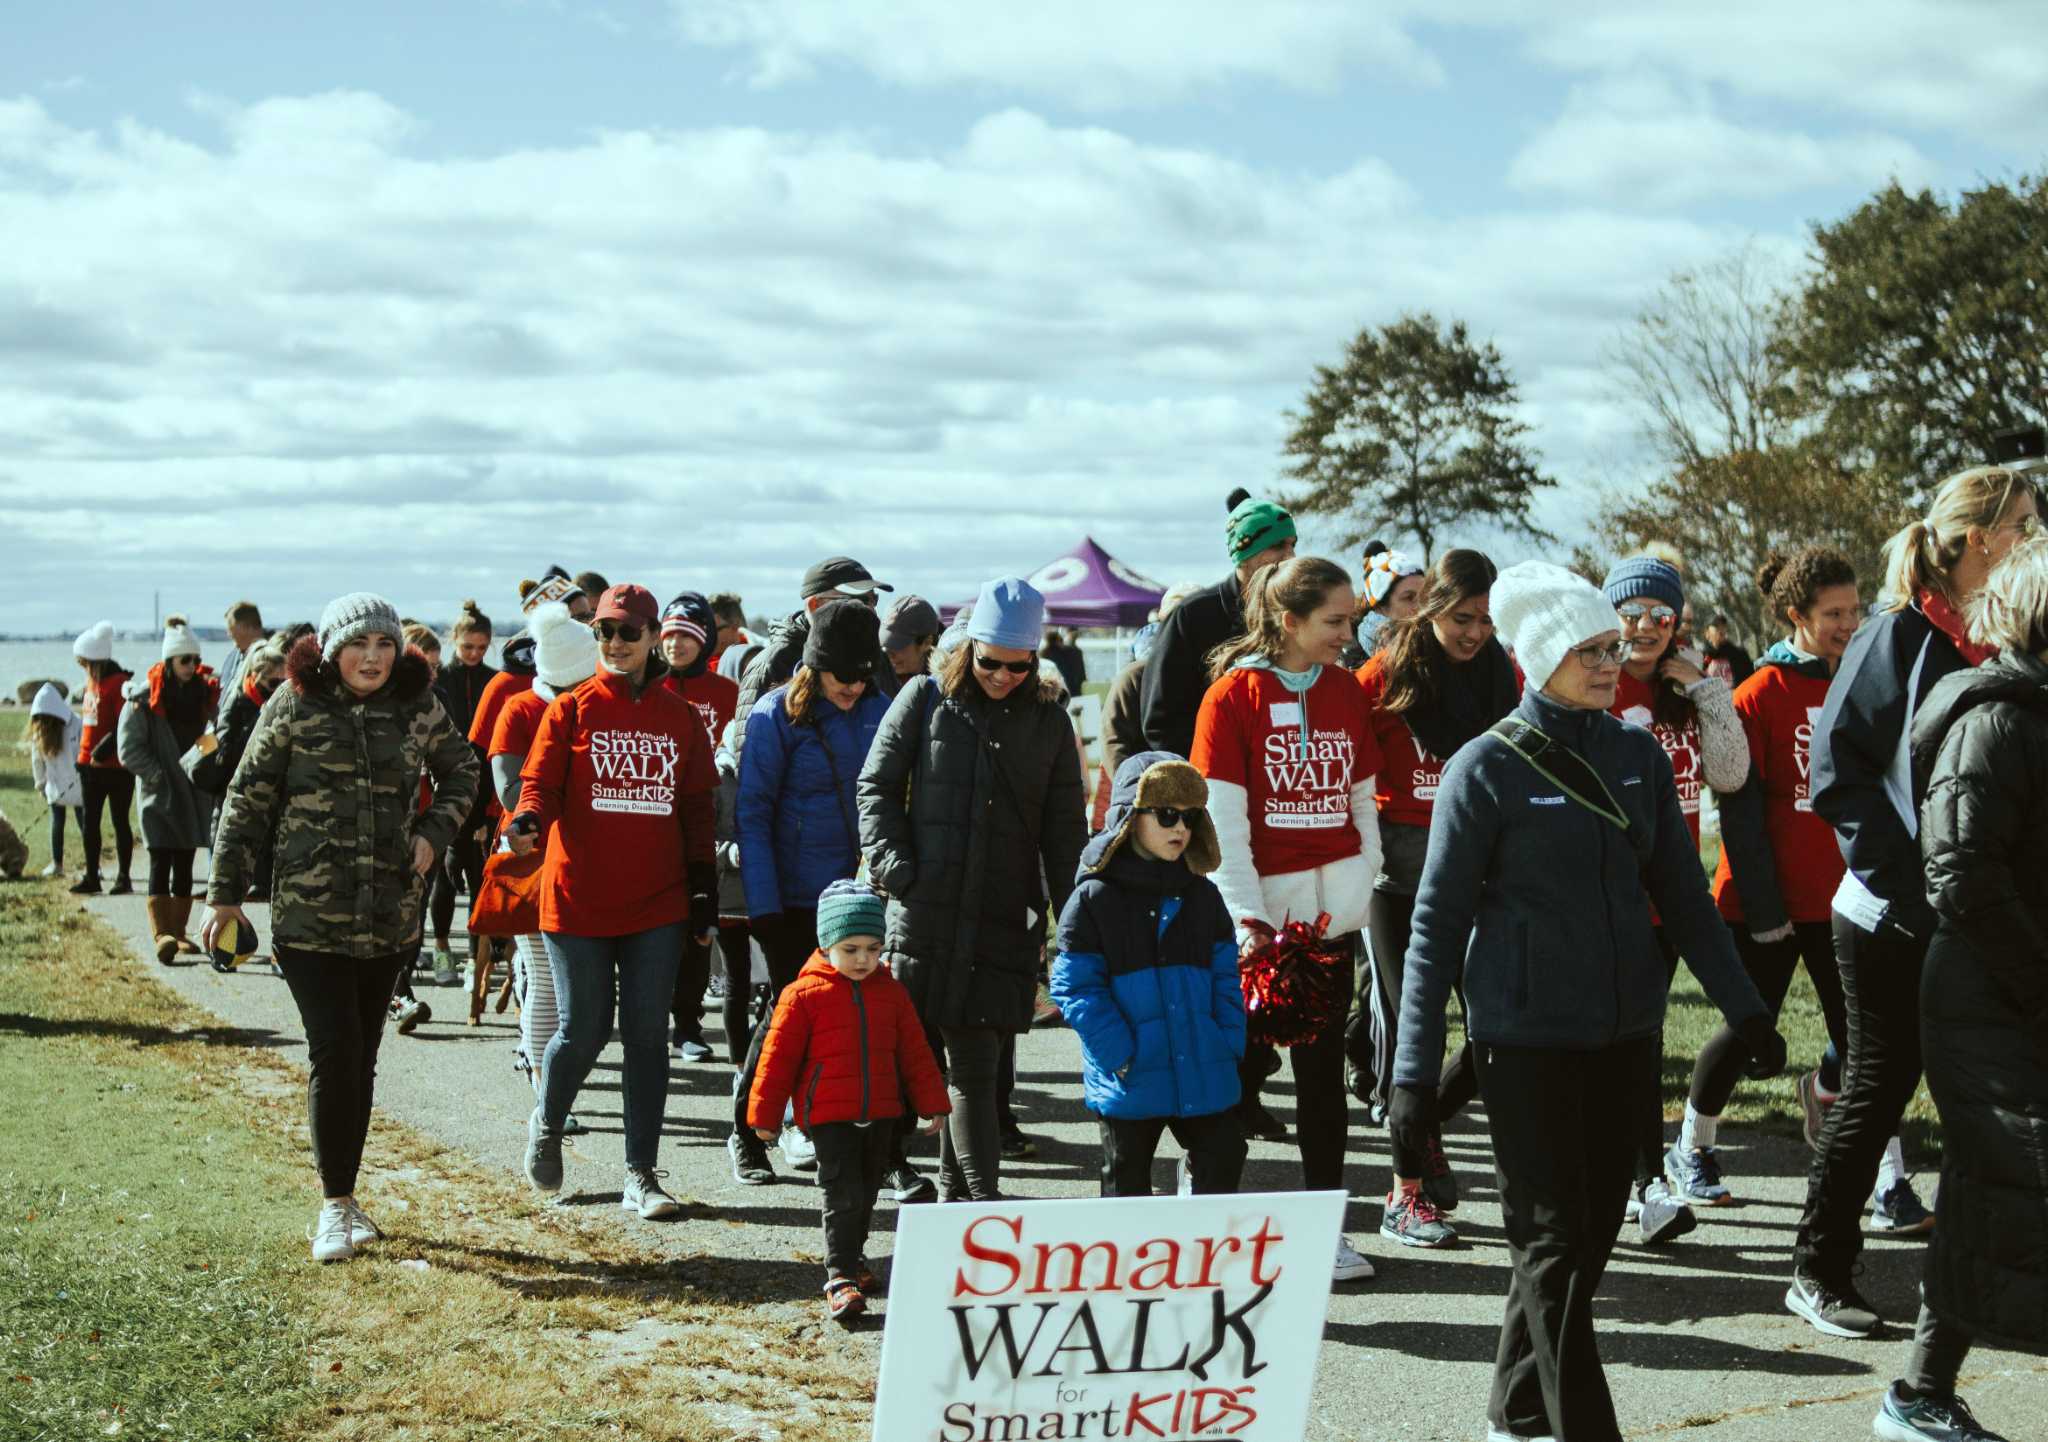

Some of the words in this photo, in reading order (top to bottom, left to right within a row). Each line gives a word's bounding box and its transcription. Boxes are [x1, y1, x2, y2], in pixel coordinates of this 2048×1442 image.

[592, 731, 677, 757] Smart
[611, 730, 632, 739] First
[635, 730, 668, 741] Annual
[1313, 728, 1346, 739] Annual
[1265, 734, 1353, 763] Smart
[590, 753, 679, 785] WALK
[1264, 754, 1354, 794] WALK
[597, 801, 629, 810] Learning
[1302, 791, 1312, 800] for
[1271, 815, 1310, 825] Learning
[954, 1215, 1284, 1298] Smart
[947, 1282, 1273, 1382] WALK
[1056, 1381, 1088, 1403] for
[1205, 1424, 1224, 1435] with
